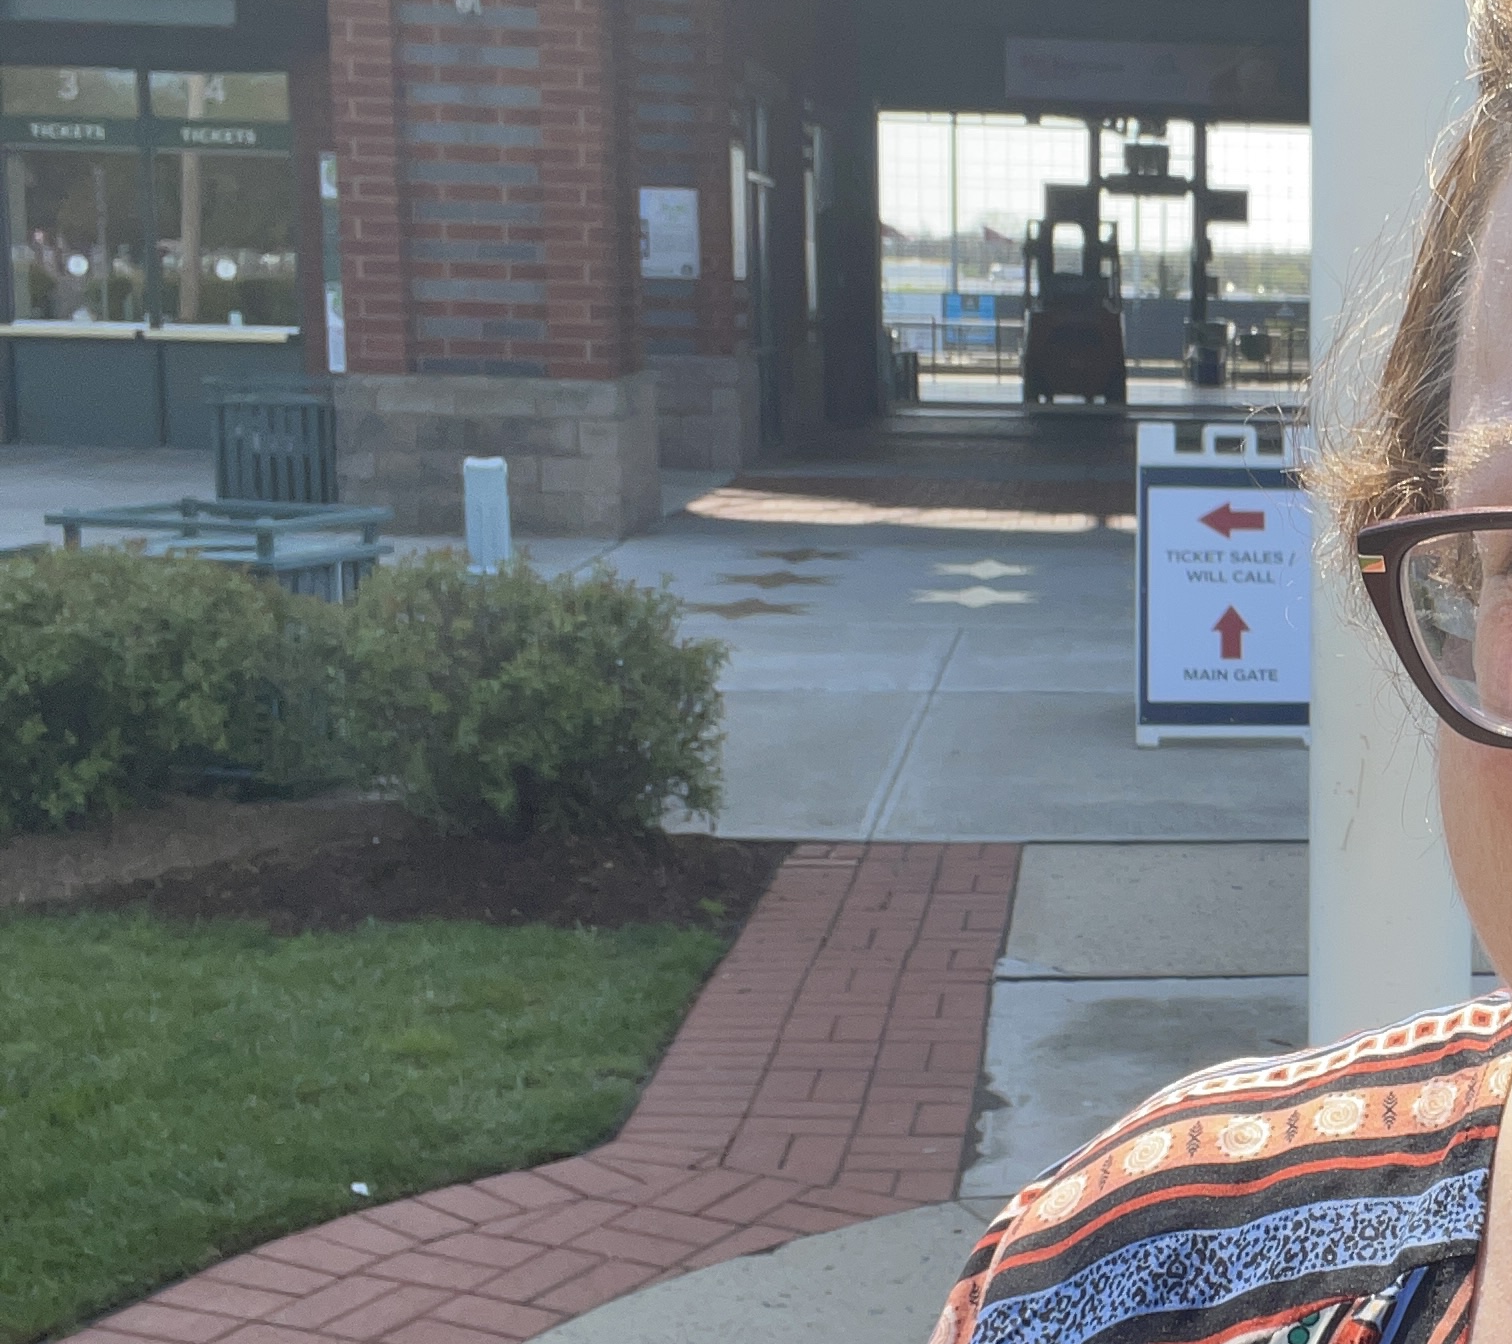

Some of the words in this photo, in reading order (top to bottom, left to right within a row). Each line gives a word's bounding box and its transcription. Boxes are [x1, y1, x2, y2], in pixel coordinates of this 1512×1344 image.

[57, 69, 78, 101] 3
[204, 74, 226, 104] 4
[29, 121, 106, 141] TICKETS
[180, 125, 257, 145] TICKETS
[1166, 549, 1224, 564] TICKET
[1229, 549, 1284, 565] SALES
[1185, 569, 1228, 584] WILL
[1232, 570, 1276, 585] CALL
[1182, 668, 1229, 682] MAIN
[1233, 668, 1279, 683] GATE
